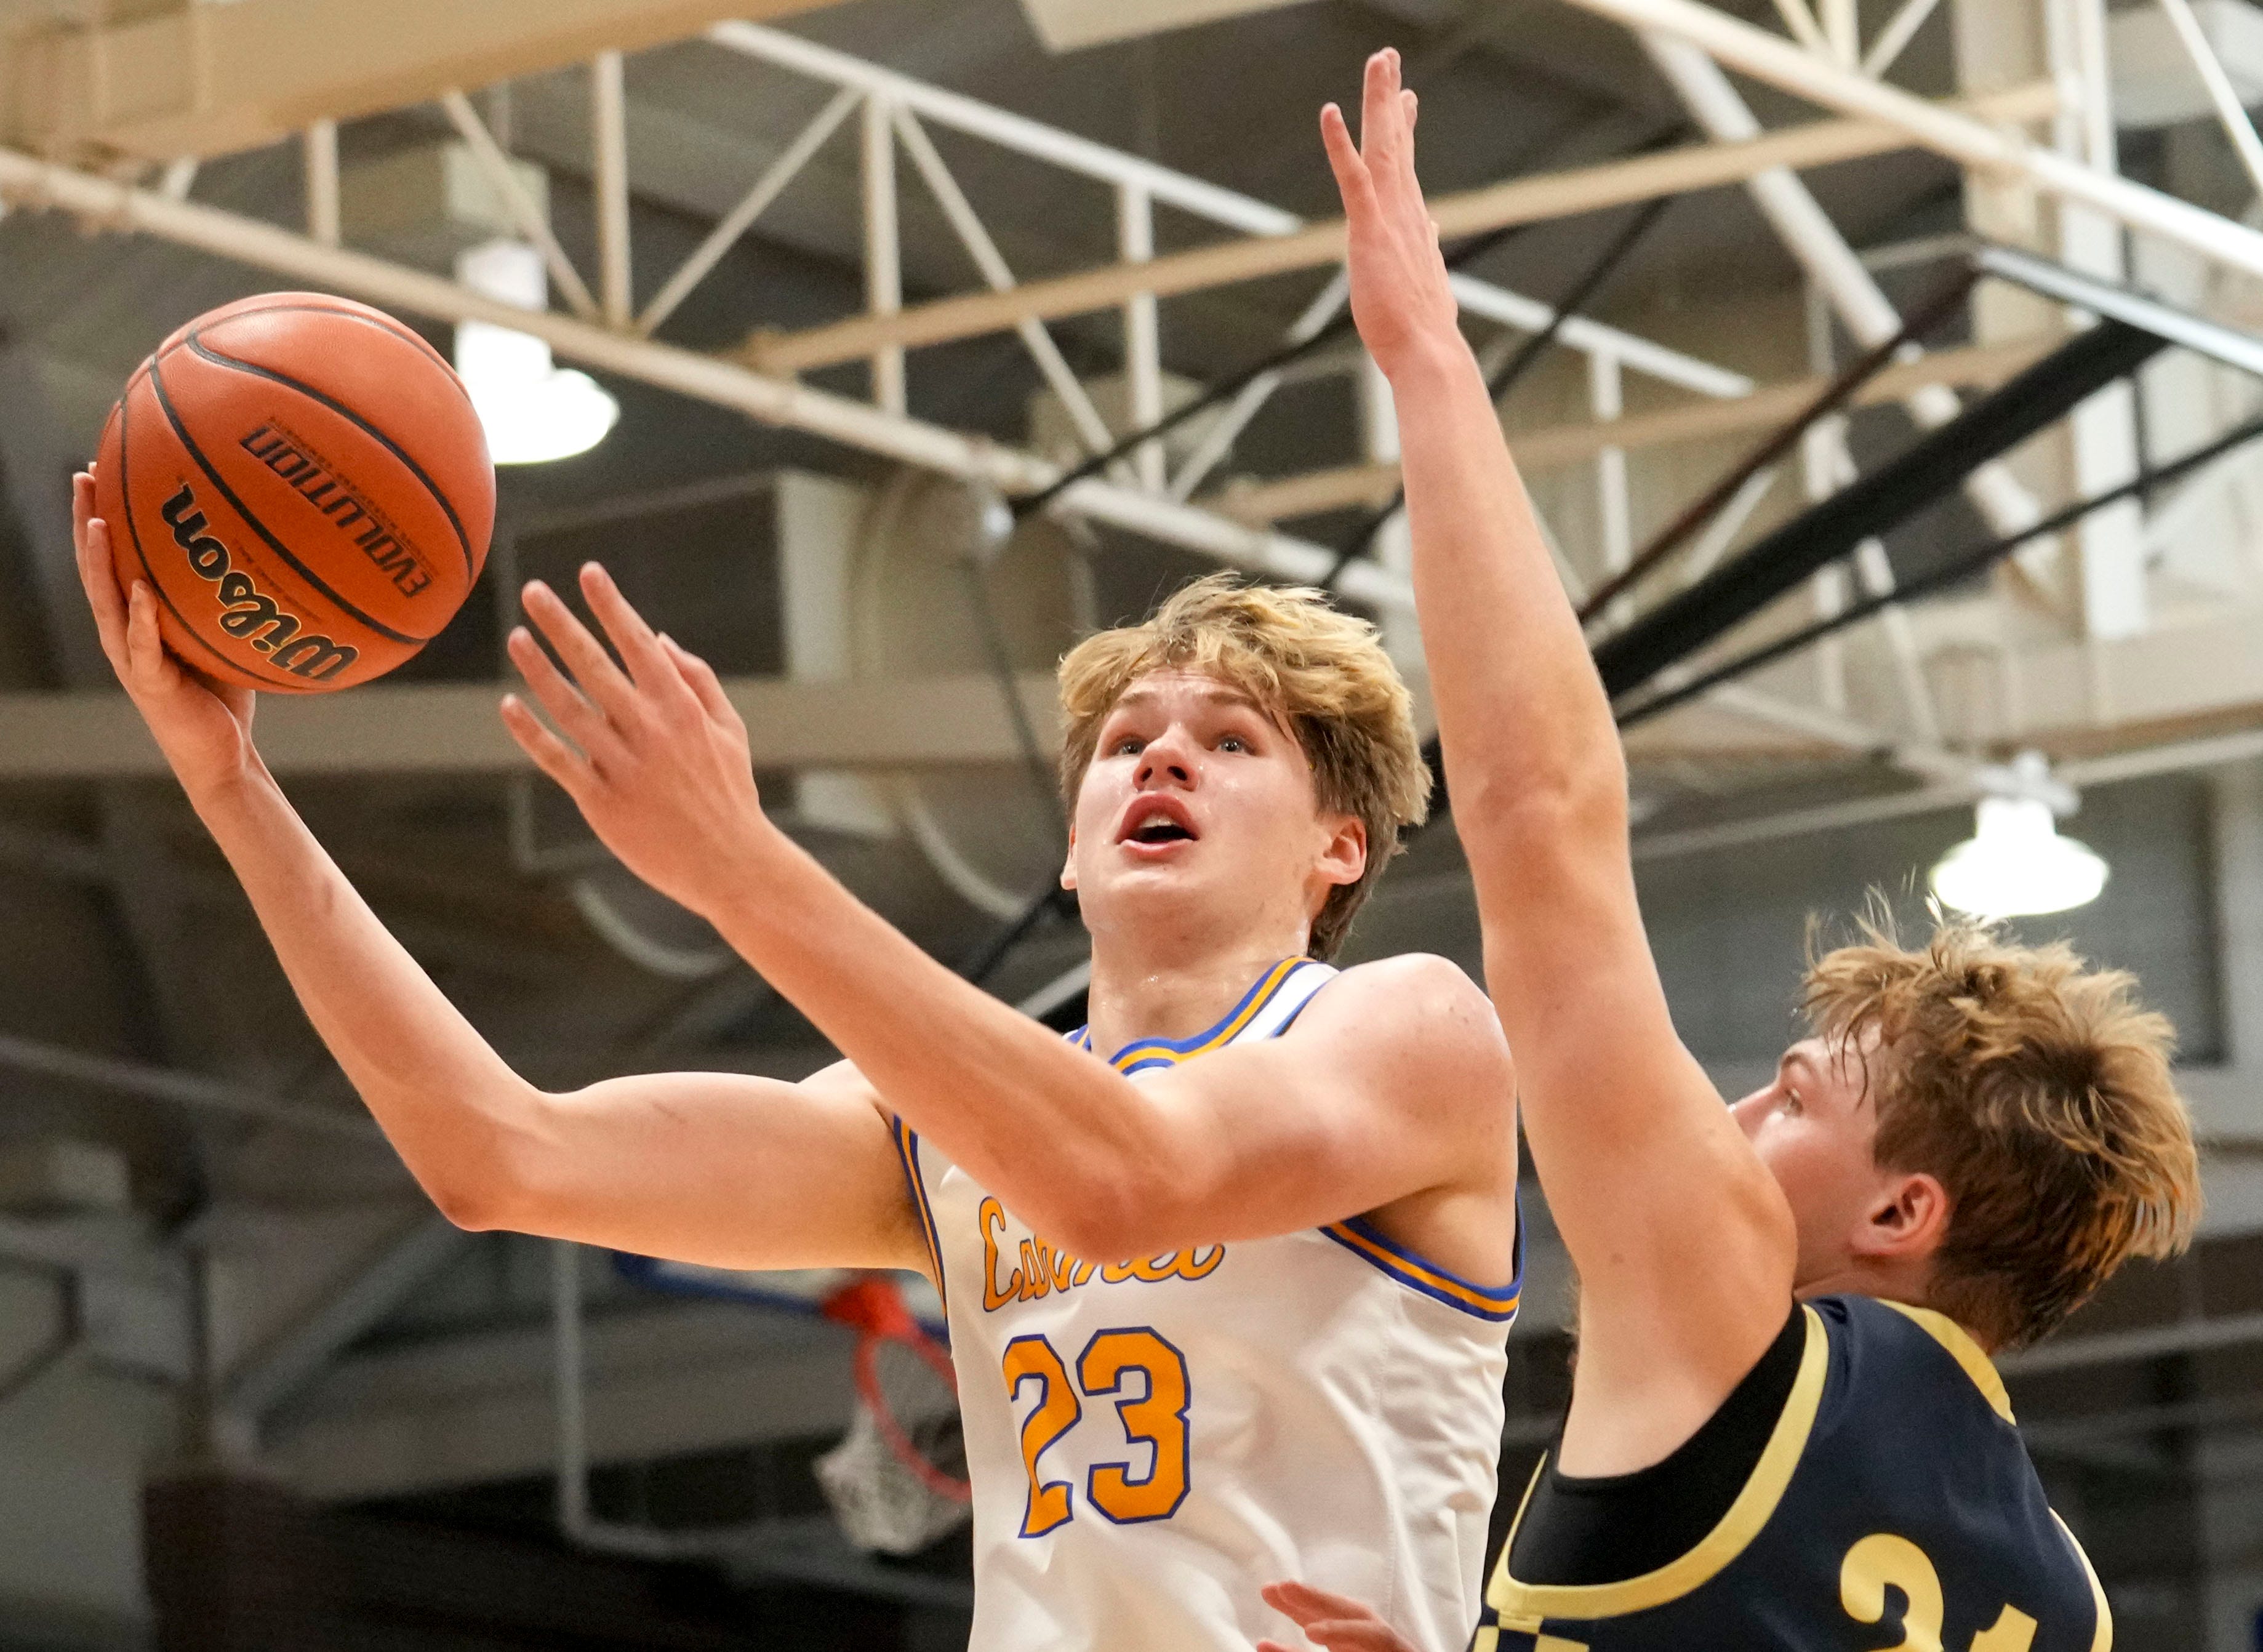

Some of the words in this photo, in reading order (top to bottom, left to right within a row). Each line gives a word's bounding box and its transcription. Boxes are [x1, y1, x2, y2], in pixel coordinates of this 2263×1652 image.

[162, 484, 359, 679] Wilson
[240, 426, 430, 597] EVOLUTION
[1003, 1326, 1191, 1538] 23
